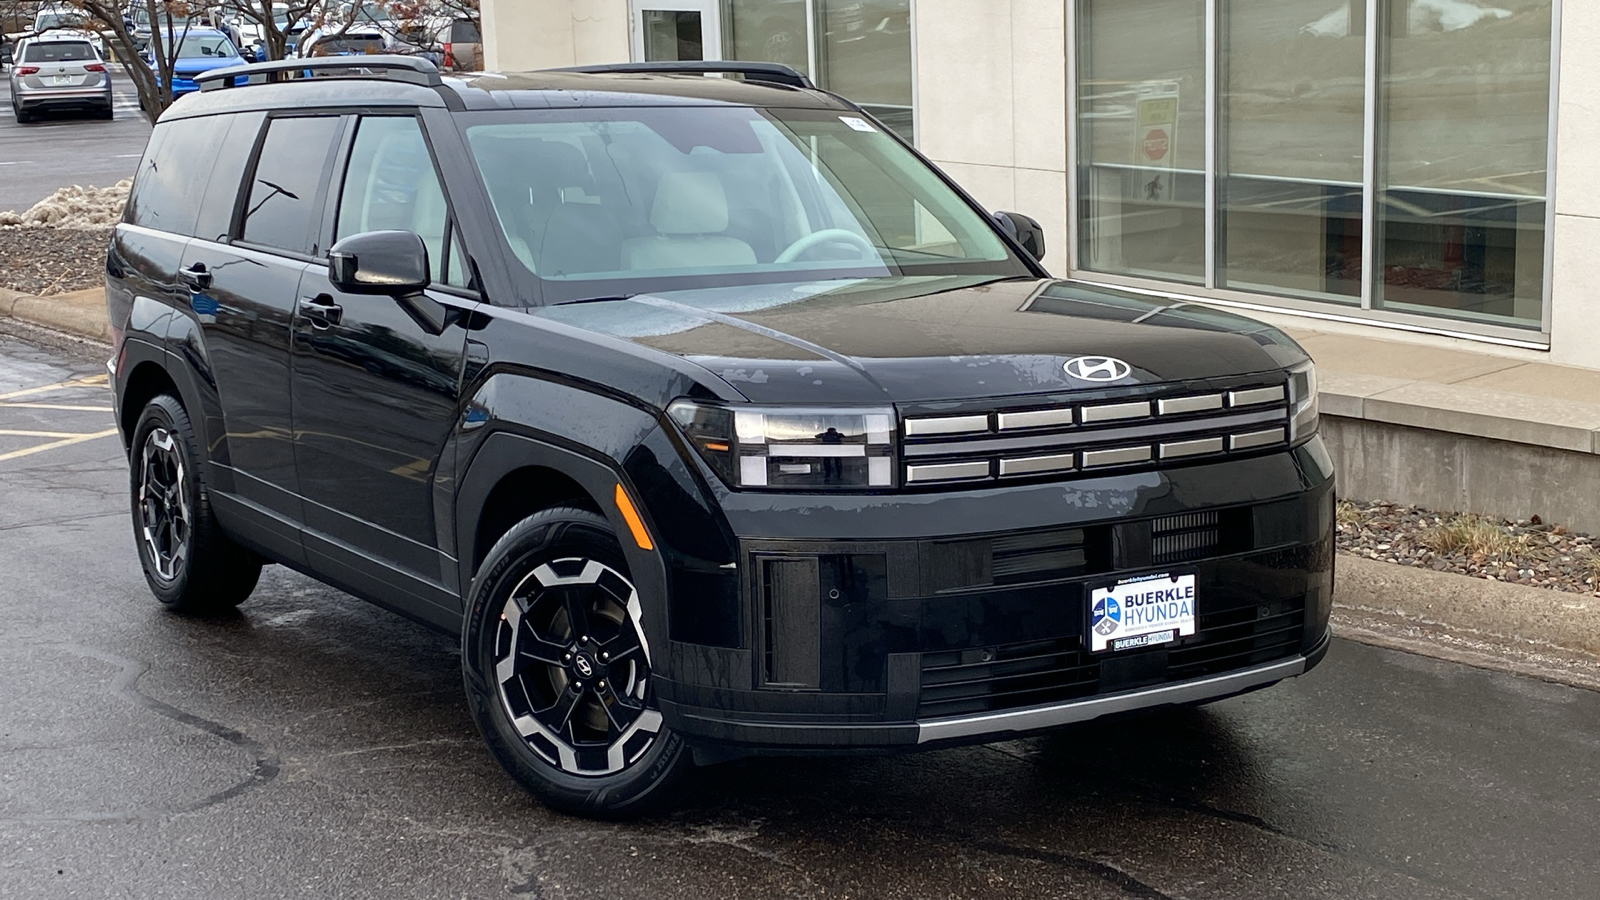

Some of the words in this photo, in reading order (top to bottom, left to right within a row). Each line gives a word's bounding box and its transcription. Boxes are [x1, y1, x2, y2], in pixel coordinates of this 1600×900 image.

[1125, 586, 1194, 608] BUERKLE
[1125, 599, 1195, 626] HYUNDAI
[1114, 636, 1148, 649] BUERKLE
[1148, 632, 1173, 644] HYUNDAI
